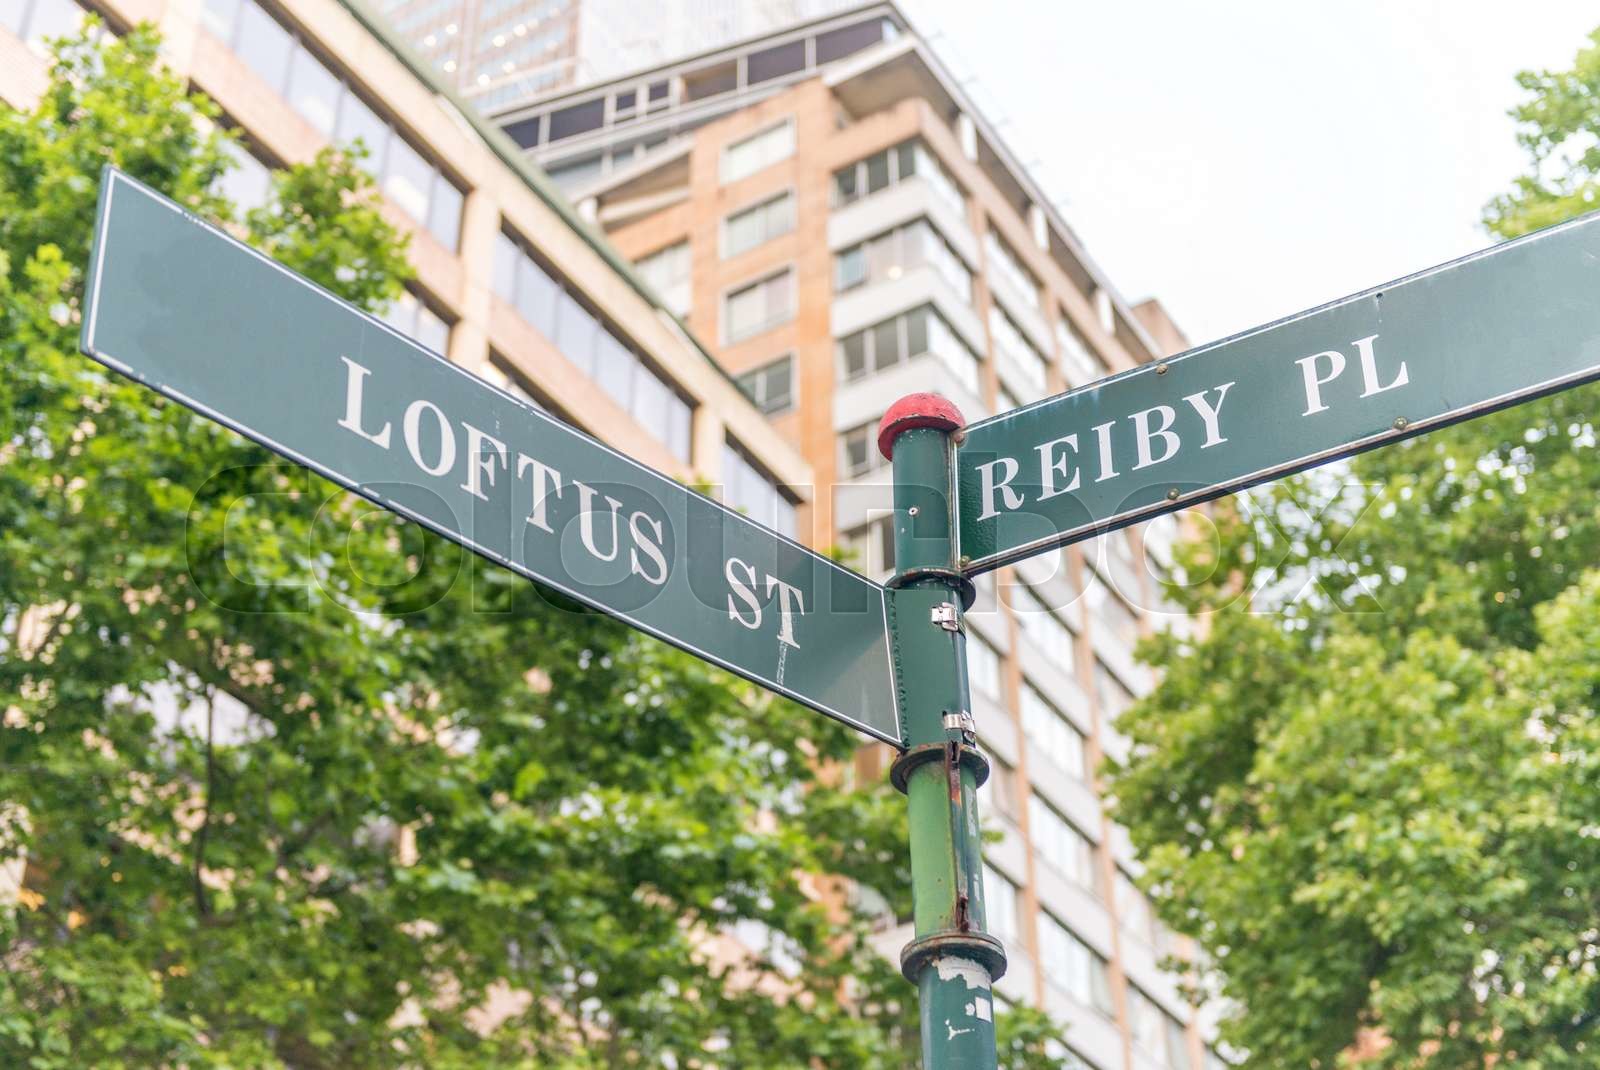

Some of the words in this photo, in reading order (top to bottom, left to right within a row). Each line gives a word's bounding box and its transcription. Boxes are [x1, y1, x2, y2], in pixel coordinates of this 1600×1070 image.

[338, 356, 667, 585] LOFTUS
[726, 557, 805, 648] ST
[976, 383, 1234, 520] REIBY
[1294, 335, 1409, 416] PL
